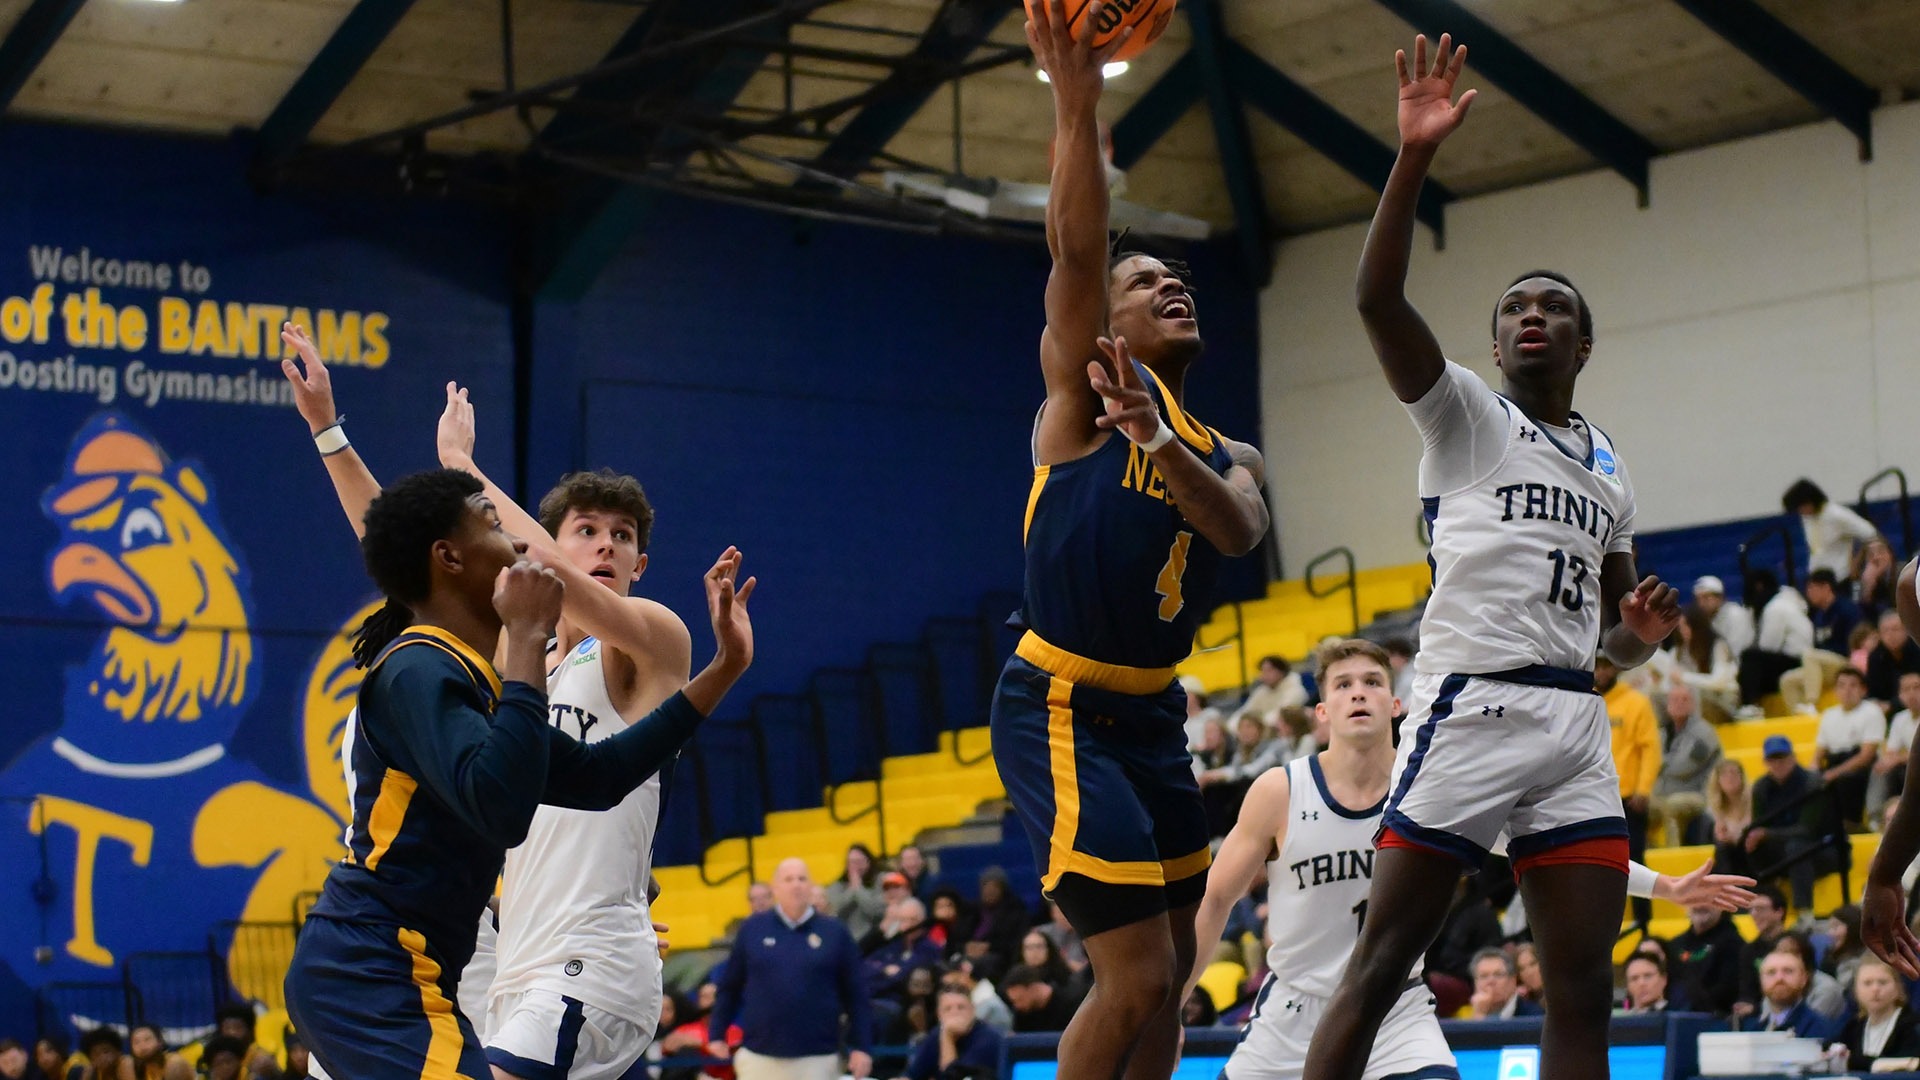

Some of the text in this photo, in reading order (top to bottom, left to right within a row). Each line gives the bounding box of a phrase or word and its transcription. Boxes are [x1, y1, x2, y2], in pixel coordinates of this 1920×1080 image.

[30, 245, 211, 292] Welcome to
[0, 283, 391, 369] of the BANTAMS
[0, 351, 117, 403] Oosting
[1154, 530, 1193, 622] 4
[1546, 548, 1588, 611] 13
[29, 794, 154, 966] T
